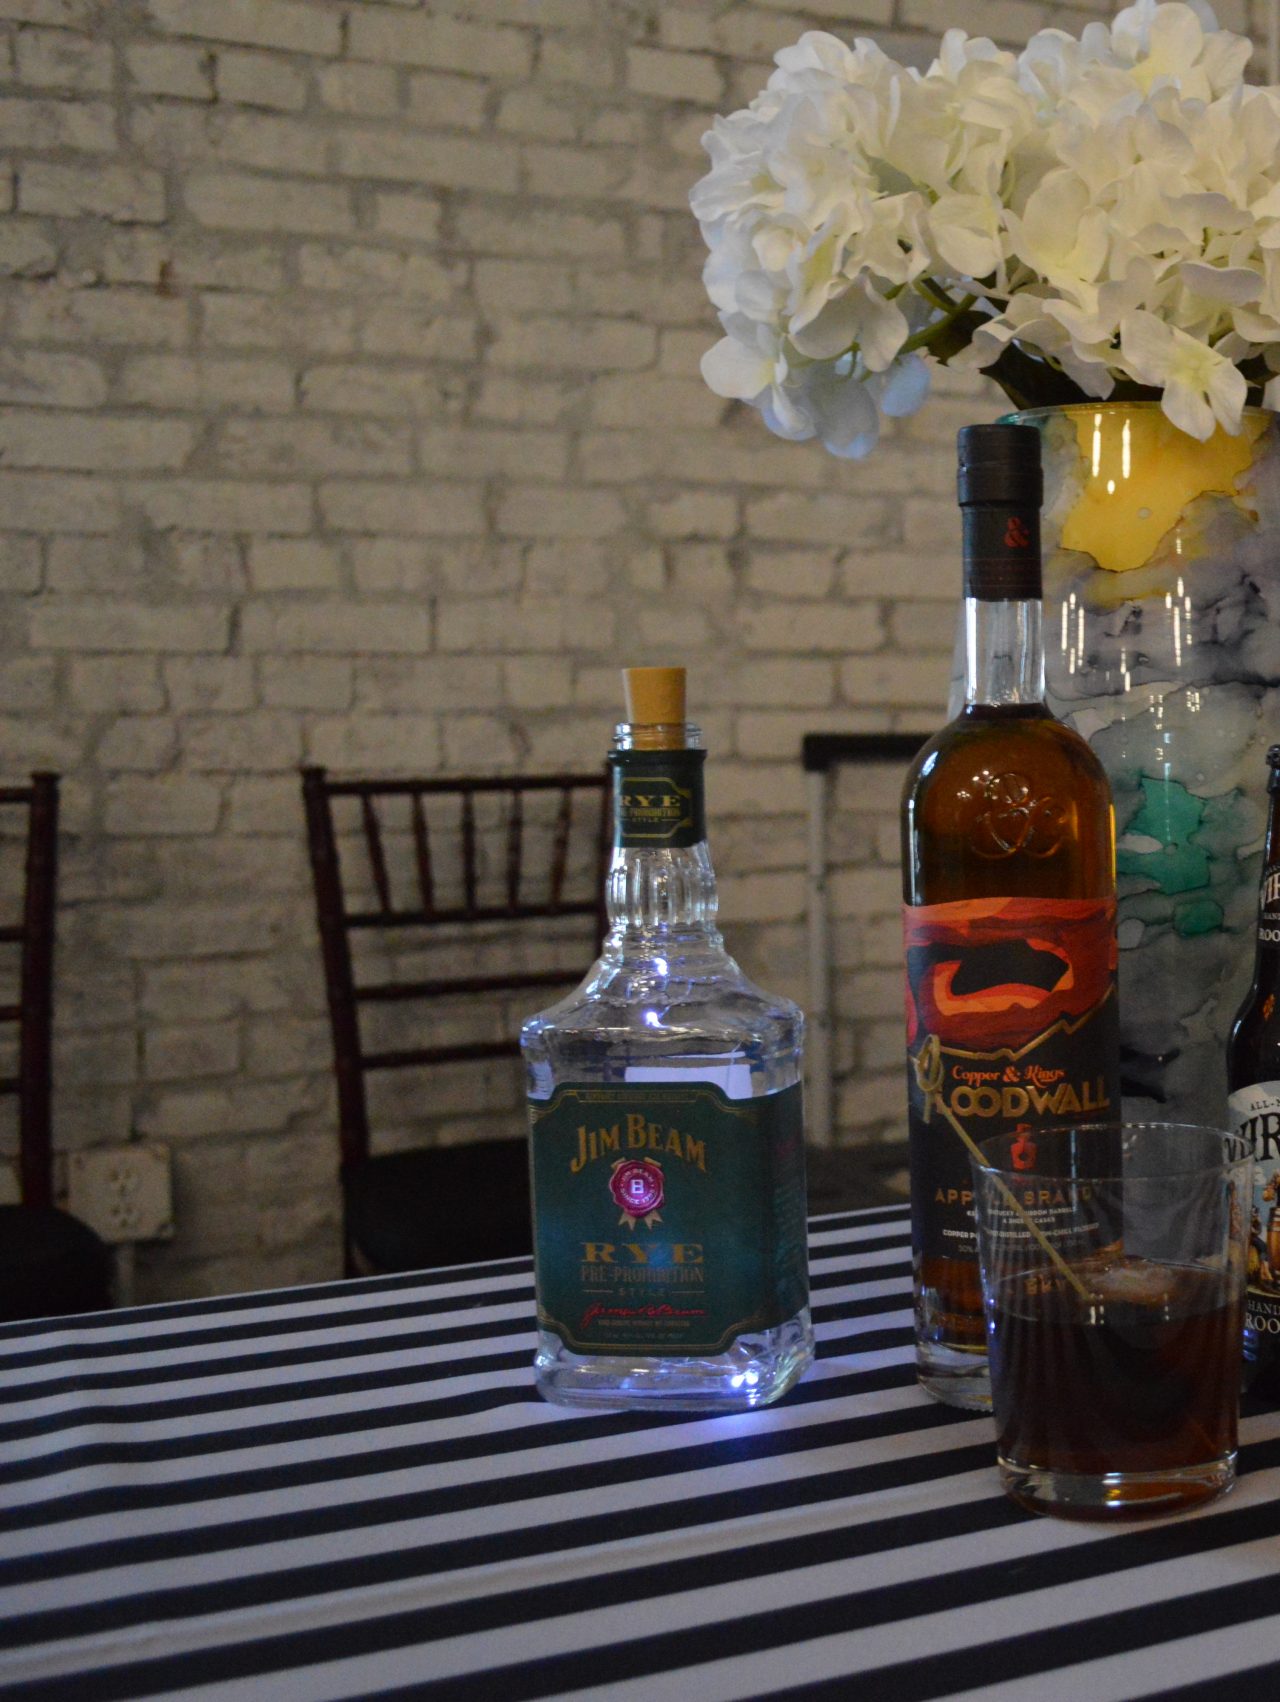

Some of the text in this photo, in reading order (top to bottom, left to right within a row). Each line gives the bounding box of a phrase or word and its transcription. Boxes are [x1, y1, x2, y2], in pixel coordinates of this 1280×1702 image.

[619, 794, 681, 807] RYE
[951, 1064, 1065, 1088] Copper & Kings
[570, 1113, 707, 1173] JIM BEAM
[631, 1179, 644, 1193] B
[580, 1242, 705, 1264] RYE
